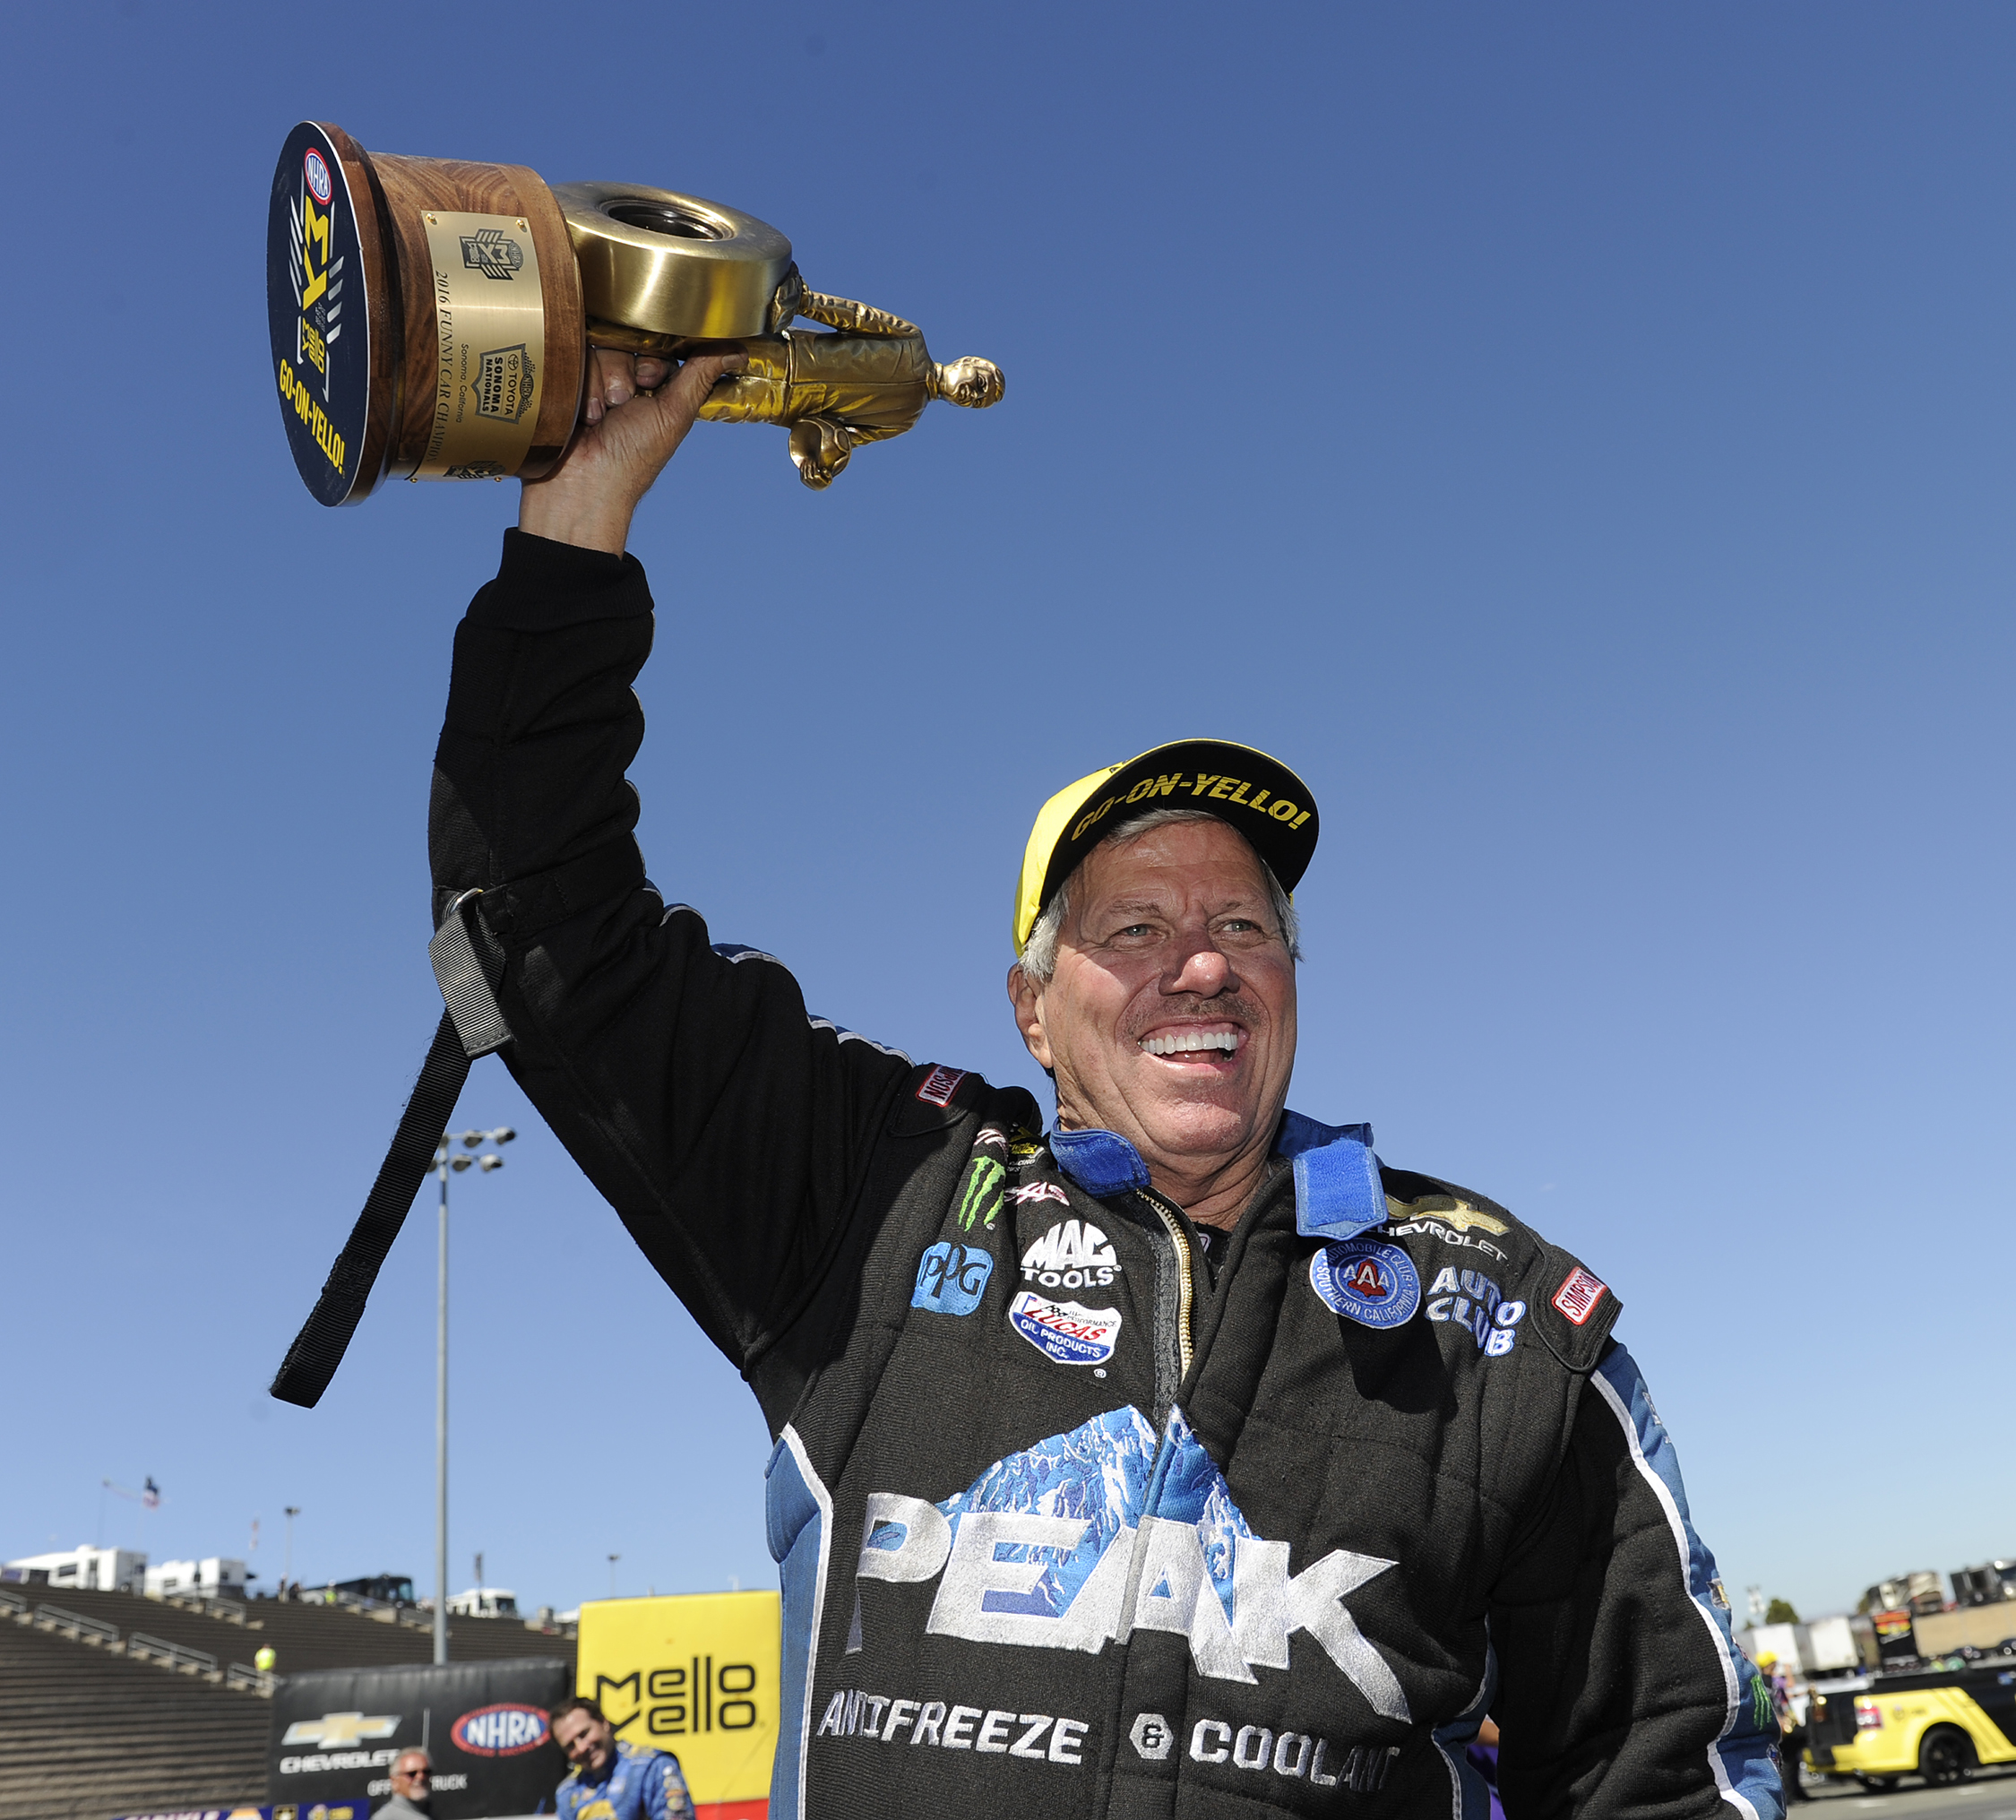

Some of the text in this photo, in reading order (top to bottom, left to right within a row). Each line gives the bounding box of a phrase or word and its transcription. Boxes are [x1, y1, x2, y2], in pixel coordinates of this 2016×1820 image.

[306, 154, 330, 199] NHRA
[426, 270, 453, 462] 2016 FUNNY CAR CHAMPION
[456, 343, 469, 423] Sonoma, California
[482, 358, 493, 411] NATIONALS
[490, 357, 504, 412] SONOMA
[280, 358, 345, 474] GO-ON-YELLO!
[504, 373, 518, 416] TOYOTA
[1071, 772, 1311, 841] GO-ON-YELLO!
[1021, 1220, 1117, 1271] MAC
[1326, 1242, 1415, 1281] AUTOMOBILE CLUB
[1367, 1221, 1508, 1262] HEVROLET
[1020, 1267, 1115, 1289] TOOLS
[1316, 1265, 1417, 1322] SOUTHERN CALIFORNIA
[1426, 1265, 1526, 1327] AUTO
[1020, 1318, 1101, 1359] OIL PRODUCTS
[1023, 1309, 1107, 1341] LUCAS
[1046, 1342, 1069, 1359] INC.
[1425, 1296, 1517, 1357] CLUB
[844, 1491, 1412, 1724] PEAK
[467, 1710, 542, 1748] NHRA
[816, 1688, 1090, 1765] ANTIFREEZE
[280, 1748, 401, 1774] CHEVROLET
[430, 1773, 468, 1791] RUCK
